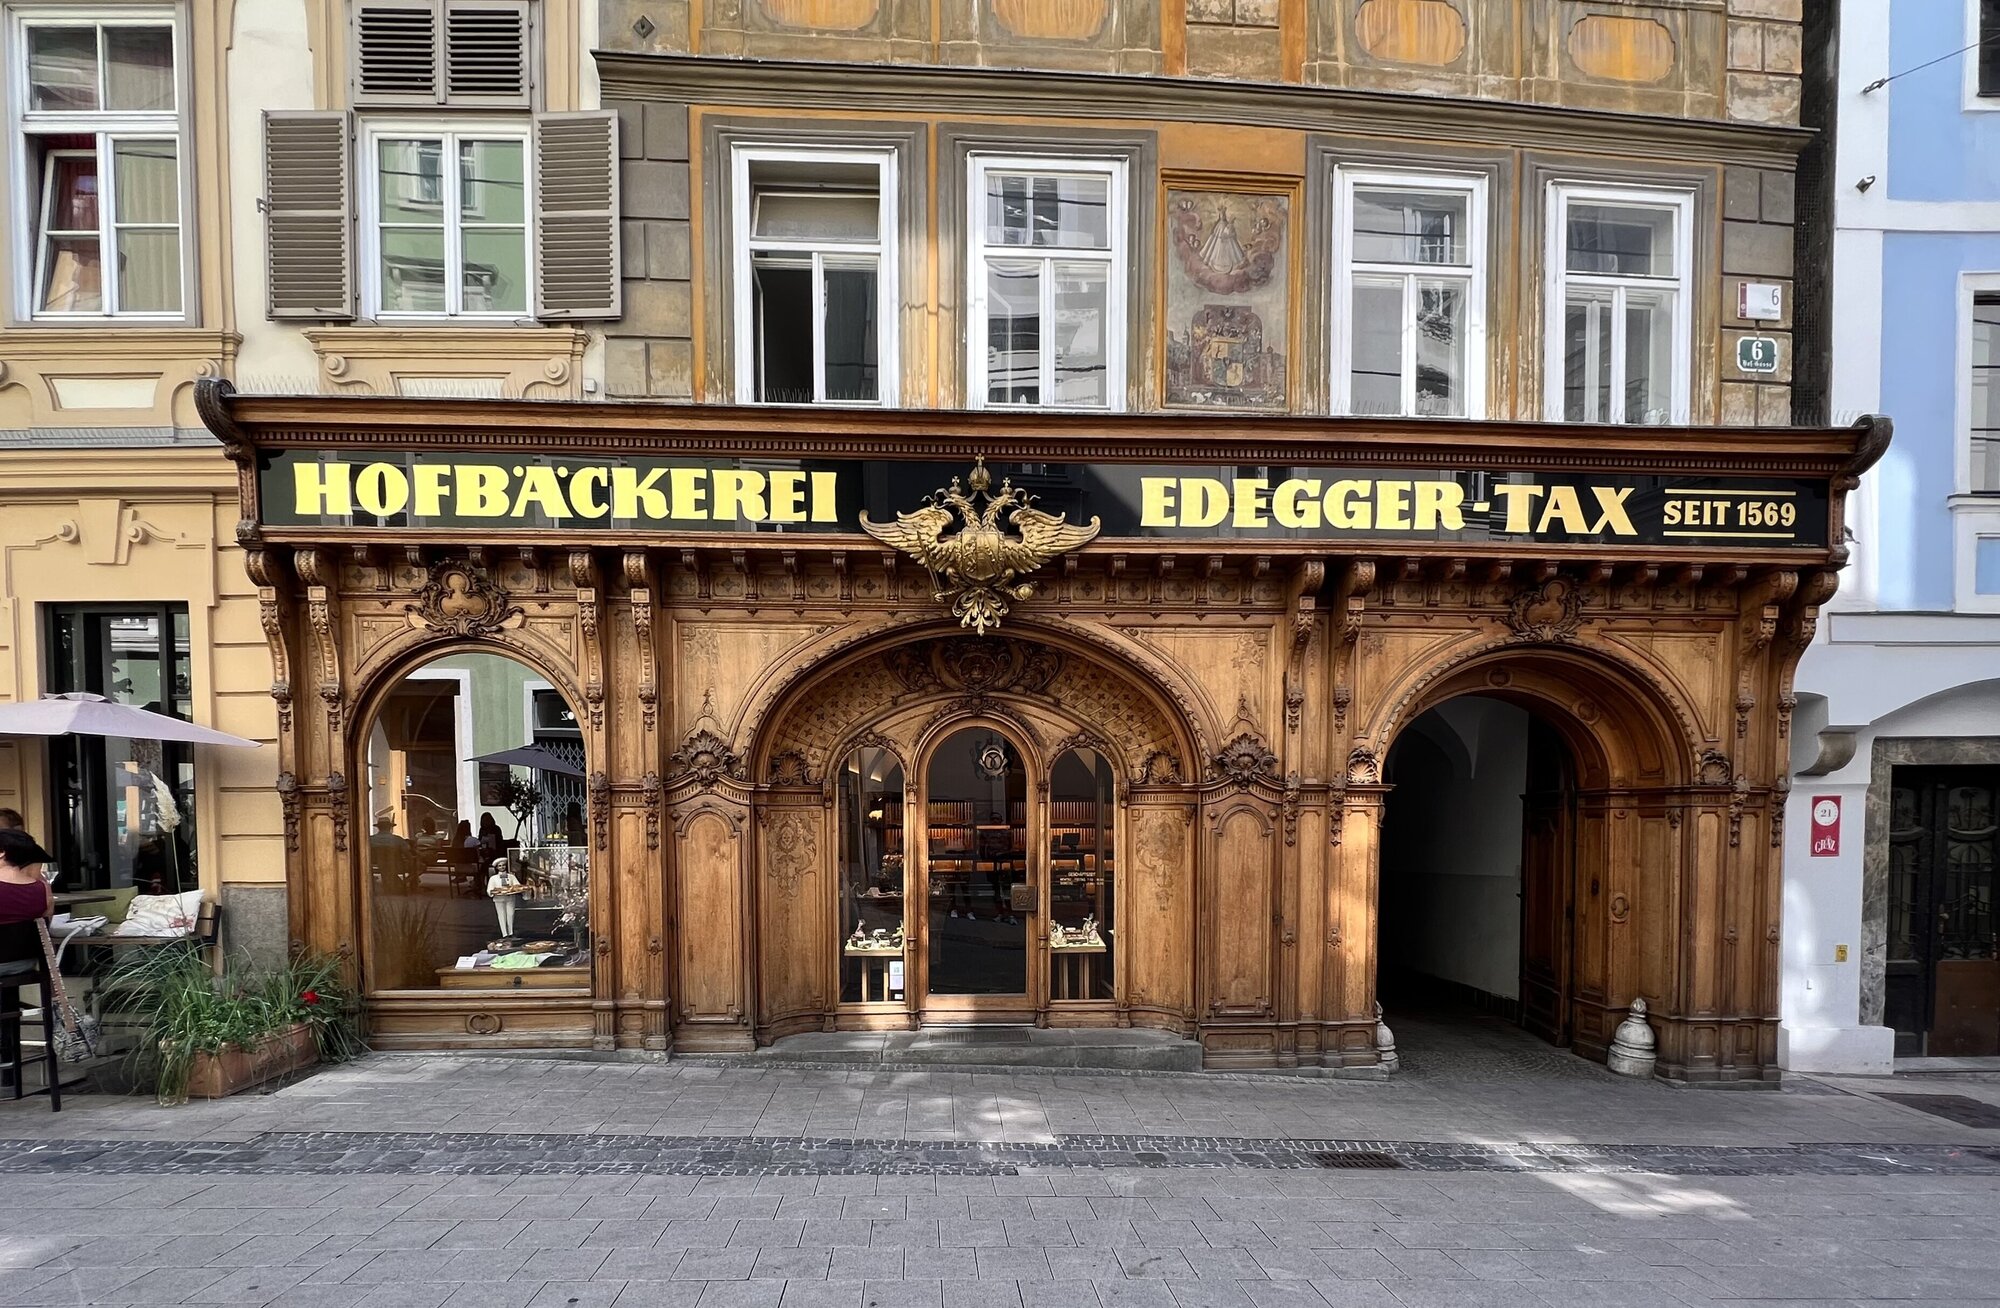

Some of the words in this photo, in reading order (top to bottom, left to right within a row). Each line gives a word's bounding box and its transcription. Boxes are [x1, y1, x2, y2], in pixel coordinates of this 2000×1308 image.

[1771, 288, 1779, 305] 6
[1751, 340, 1763, 360] 6
[293, 462, 838, 524] HOFBÄCKEREI
[1141, 477, 1637, 536] EDEGGER-TAX
[1663, 500, 1730, 525] SEIT
[1738, 503, 1797, 527] 1569
[1820, 809, 1831, 818] 21
[1814, 838, 1836, 853] GRAZ
